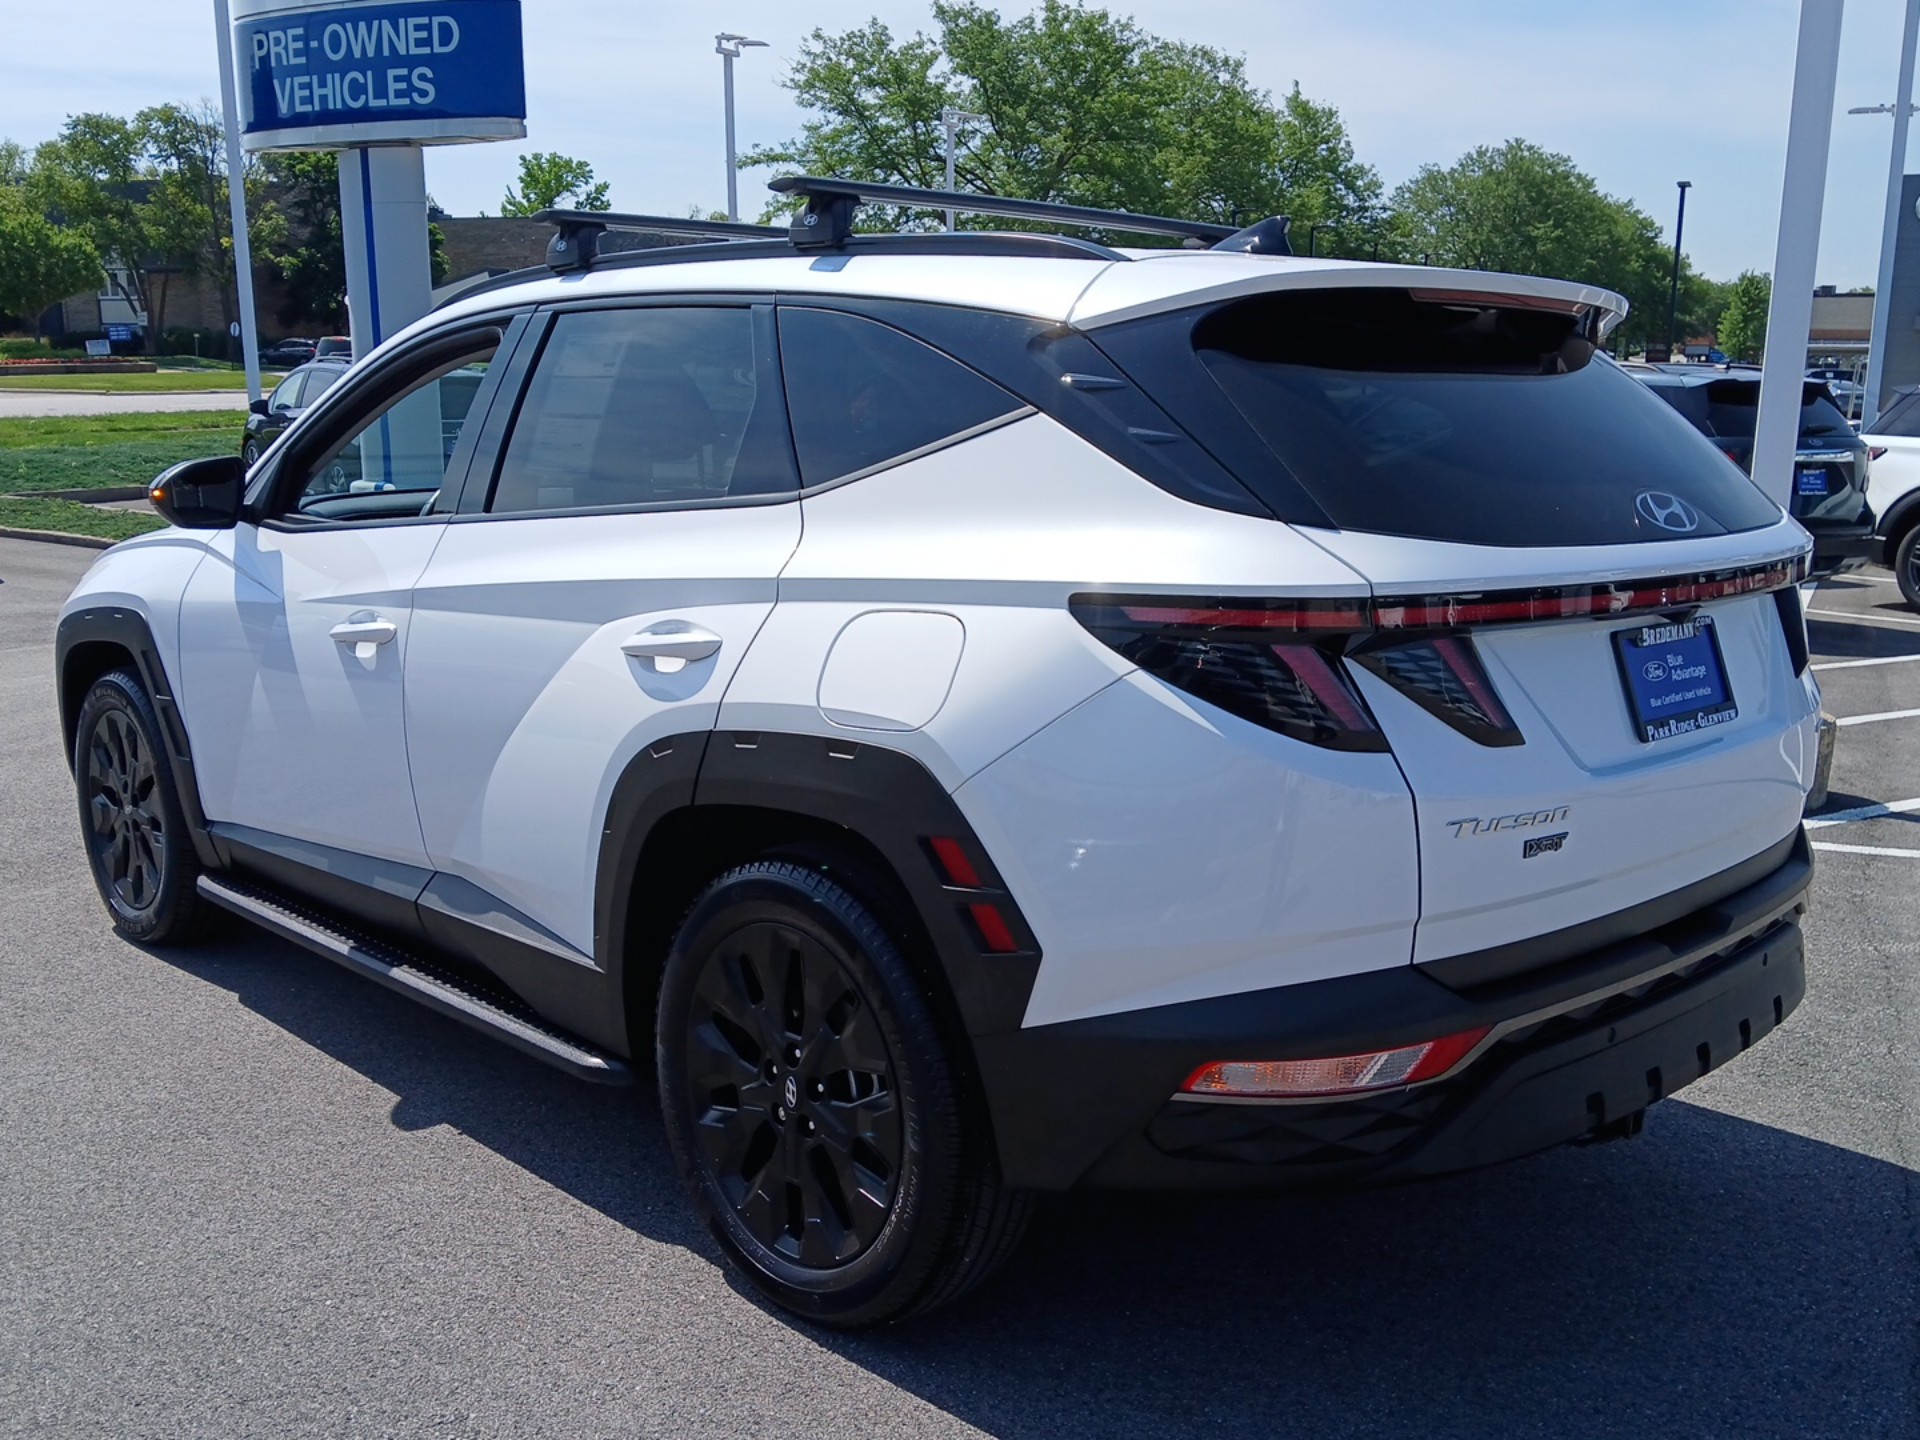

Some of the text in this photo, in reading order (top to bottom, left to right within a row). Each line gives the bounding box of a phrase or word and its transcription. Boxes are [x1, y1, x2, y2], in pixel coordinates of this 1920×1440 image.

[252, 15, 460, 69] PRE-OWNED
[273, 66, 436, 114] VEHICLES
[1666, 654, 1684, 667] Blue
[1671, 665, 1707, 682] Advantage
[1650, 686, 1712, 708] Blue Certified Used Vehicle
[1446, 805, 1571, 839] TUCSON
[1527, 832, 1569, 857] XRT
